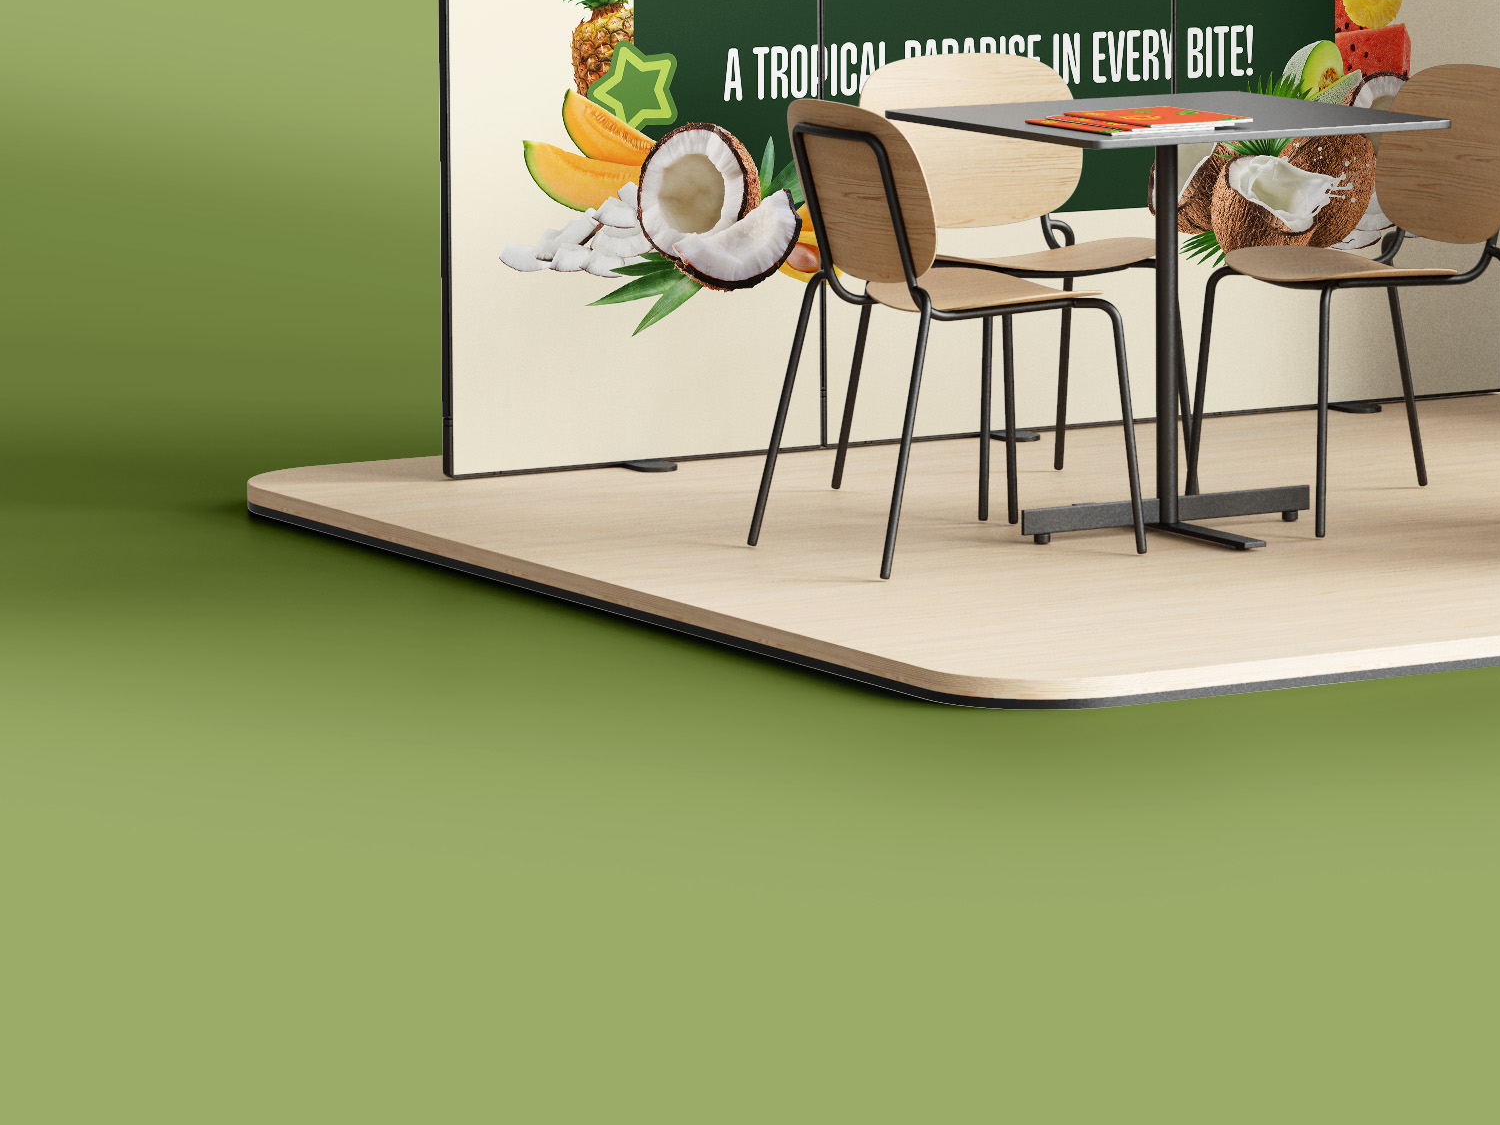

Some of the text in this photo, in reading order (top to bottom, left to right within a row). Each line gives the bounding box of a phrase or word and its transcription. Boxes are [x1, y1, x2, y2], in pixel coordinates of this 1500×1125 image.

[723, 48, 743, 102] A
[1053, 32, 1081, 84] IN
[1092, 28, 1172, 84] EVERY
[1187, 25, 1254, 79] BITE!
